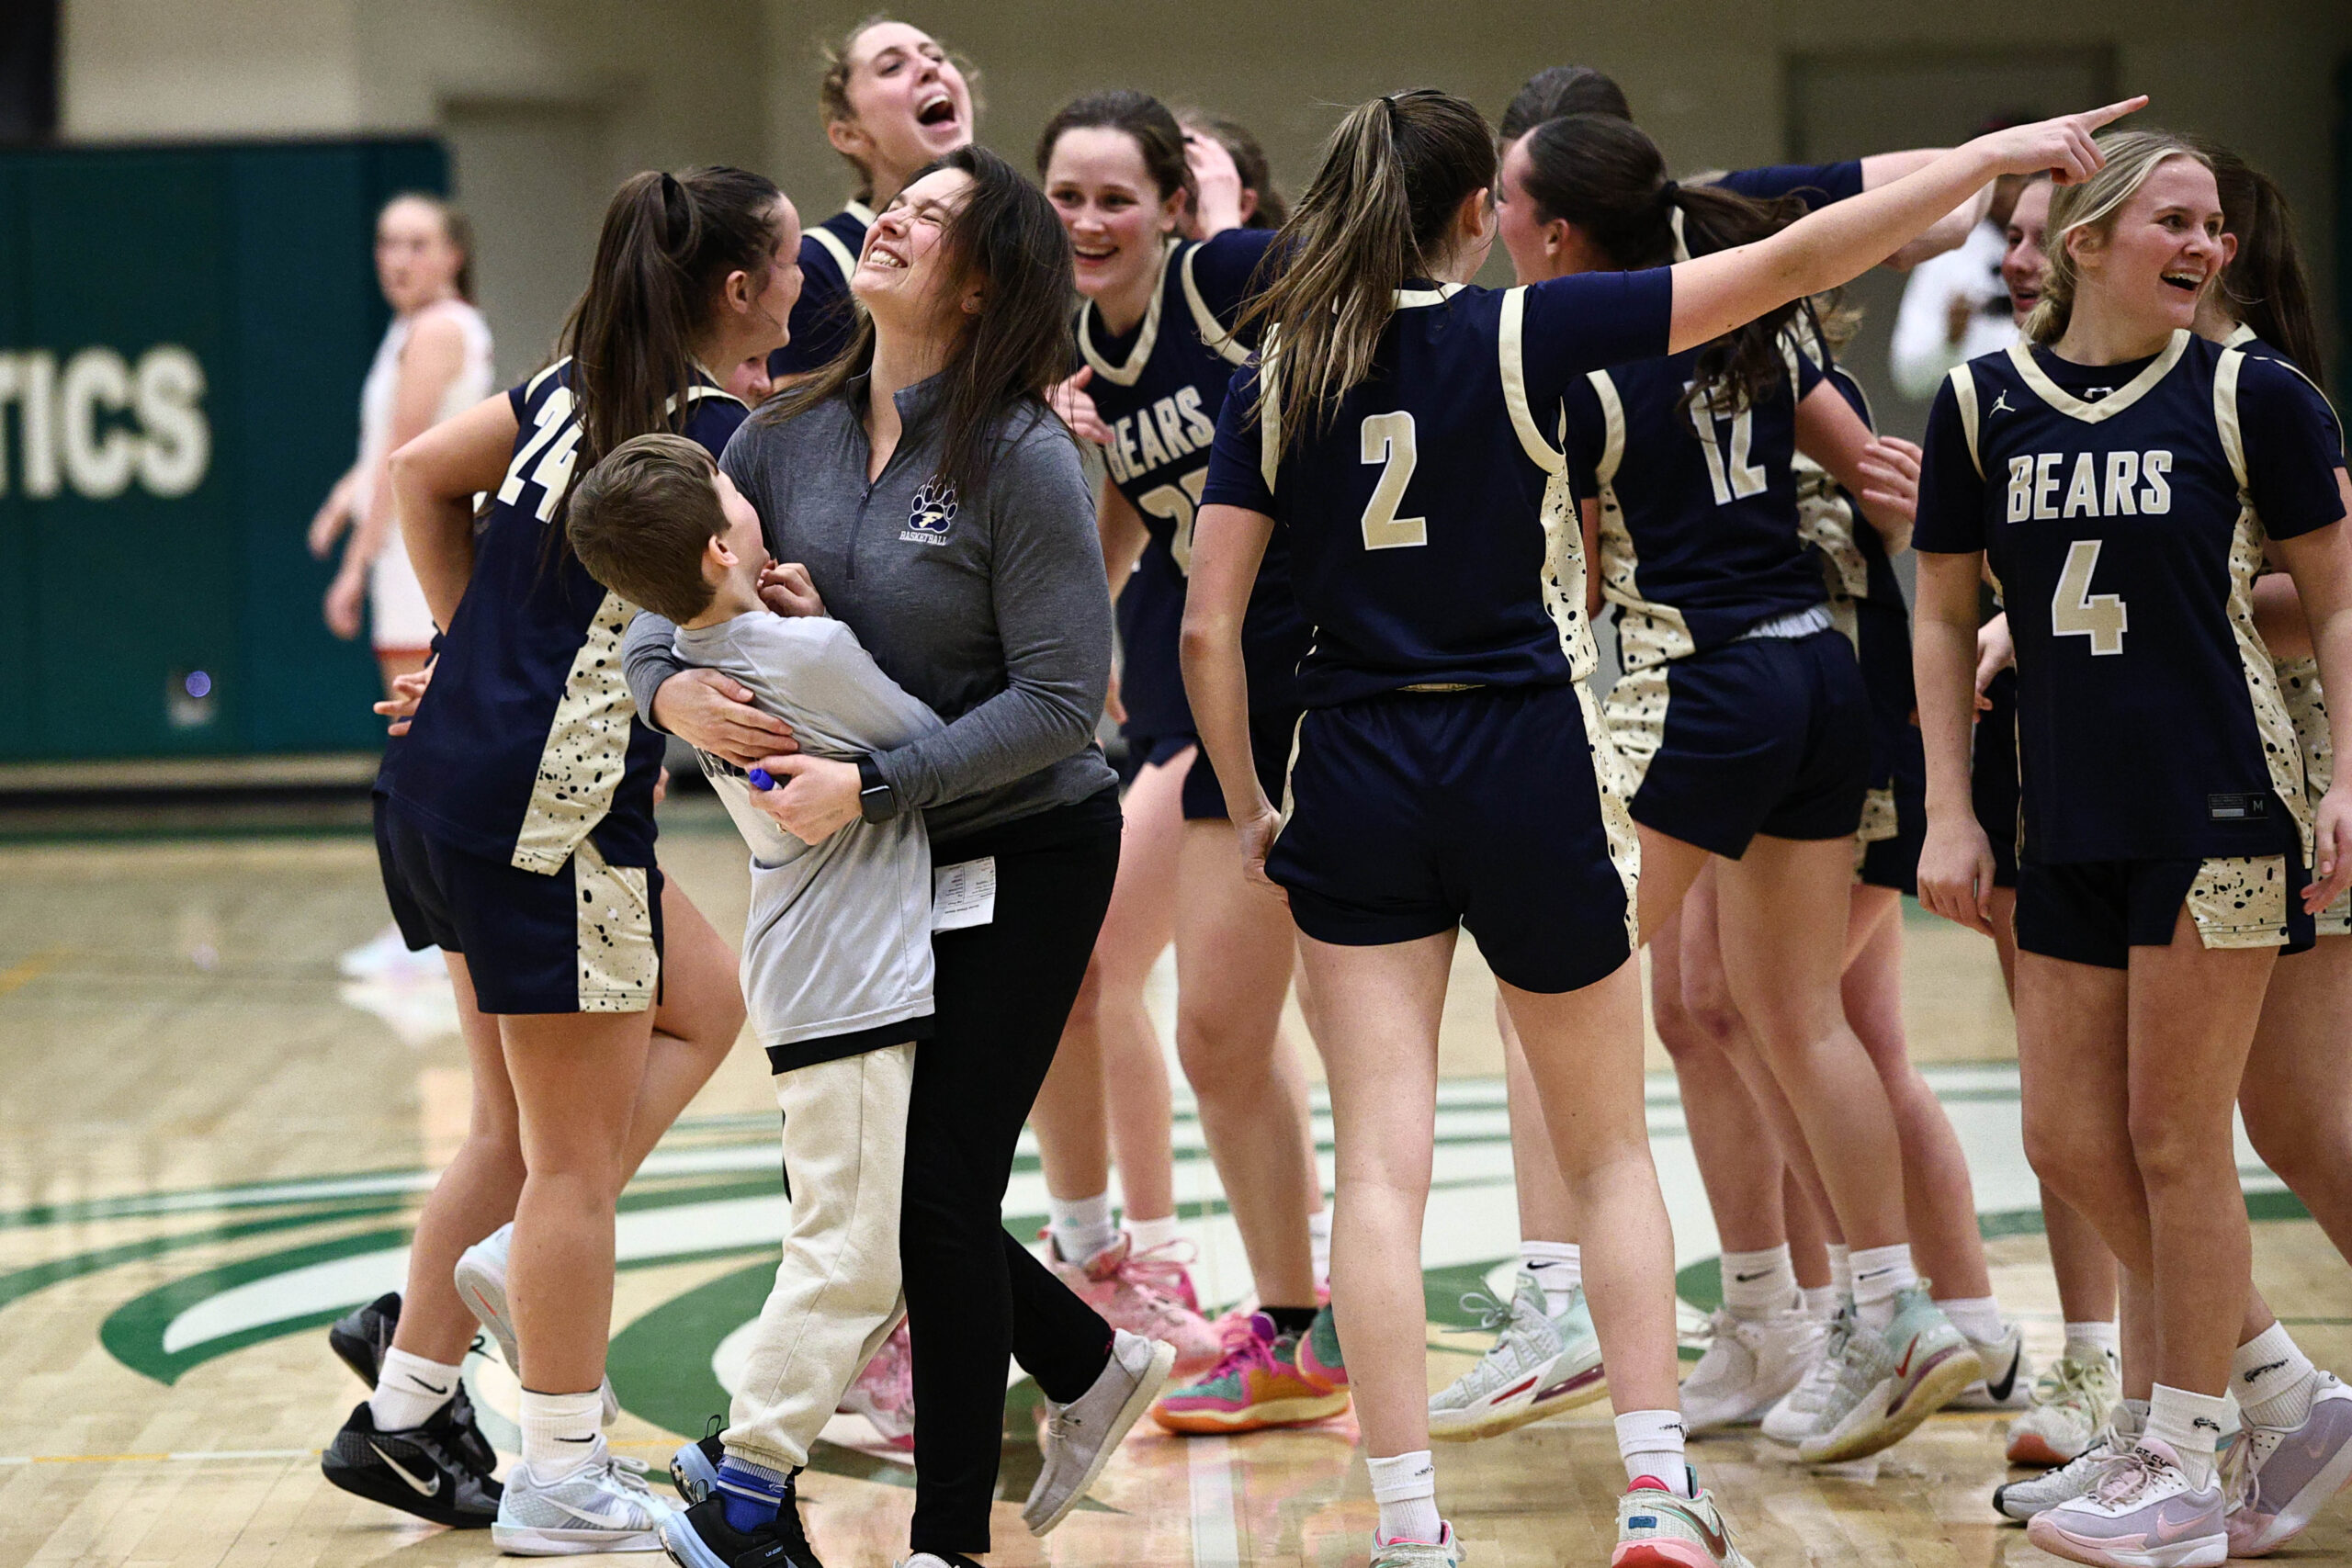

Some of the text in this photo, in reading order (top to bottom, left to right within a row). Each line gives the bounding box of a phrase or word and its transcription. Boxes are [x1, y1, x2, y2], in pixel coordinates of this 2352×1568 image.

[497, 386, 587, 525] 24
[1360, 410, 1428, 551] 2
[2007, 449, 2173, 524] BEARS
[899, 530, 947, 546] BASKETBALL
[1138, 466, 1209, 578] 2
[2052, 539, 2128, 656] 4
[2253, 800, 2264, 812] M
[2151, 1454, 2173, 1468] CU
